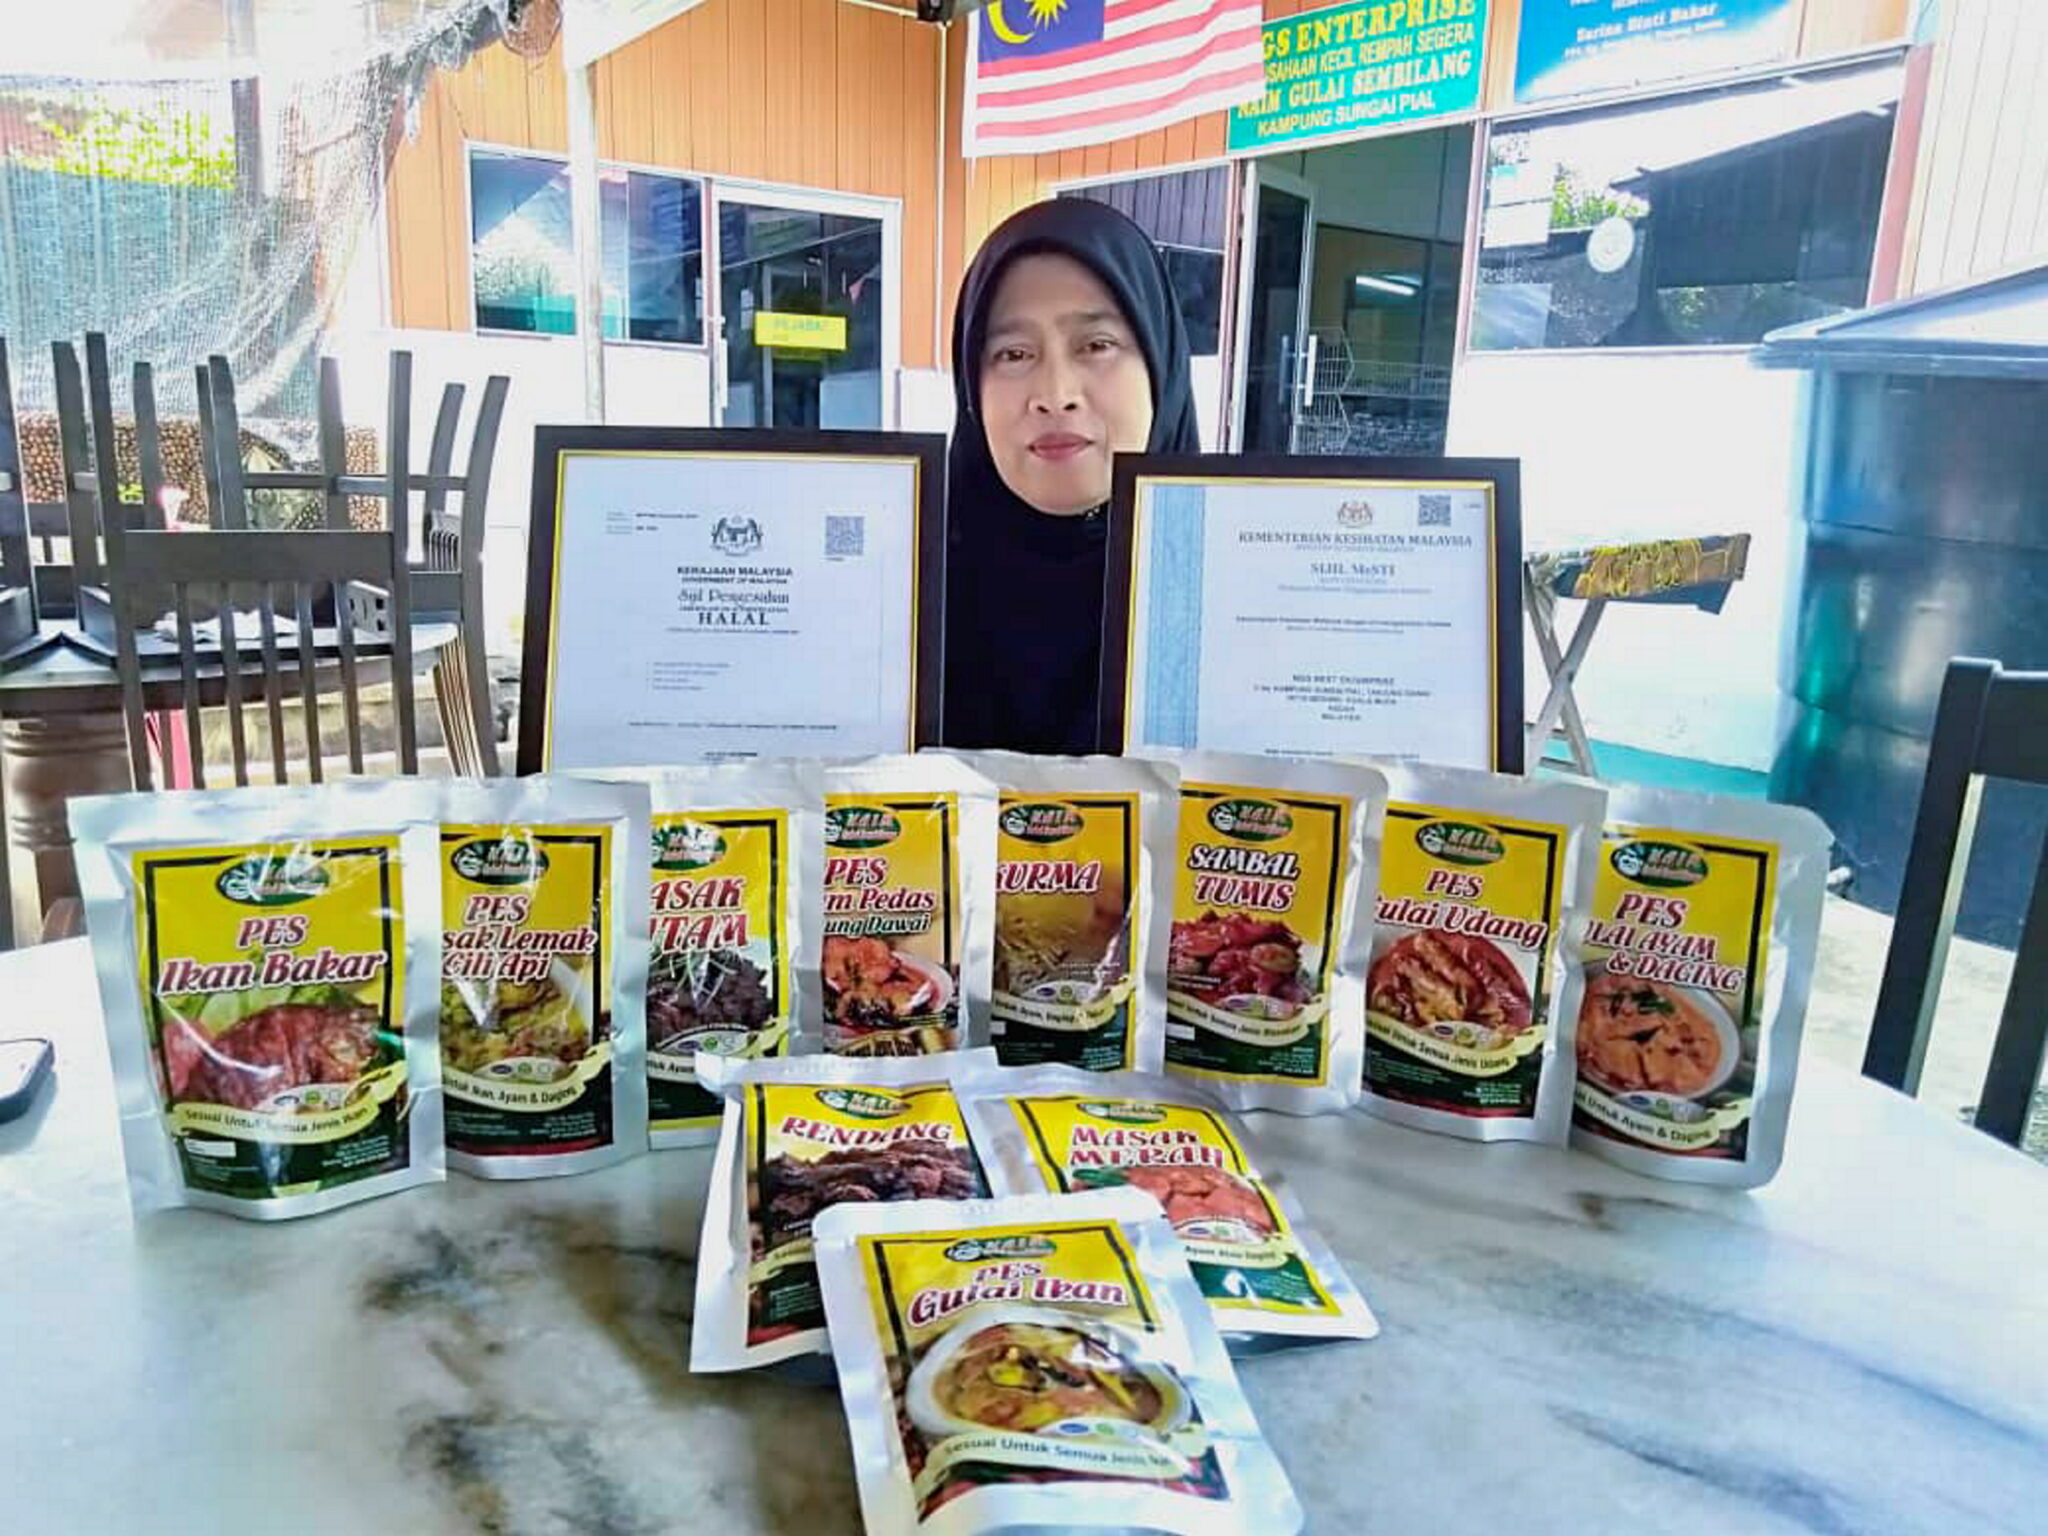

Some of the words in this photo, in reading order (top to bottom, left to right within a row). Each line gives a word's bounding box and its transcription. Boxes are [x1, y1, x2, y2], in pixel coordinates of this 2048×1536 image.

[1296, 0, 1476, 52] ENTERPRISE
[1265, 52, 1319, 82] SAHAAN
[1320, 46, 1355, 72] KECIL
[1358, 36, 1413, 65] REMPAH
[1416, 22, 1476, 52] SEGERA
[1289, 75, 1346, 108] GULAI
[1257, 108, 1332, 137] KAMPUNG
[1335, 95, 1397, 123] SUNGAI
[1238, 531, 1331, 545] KEMENTERIAN
[1334, 532, 1405, 546] KESIHATAN
[1408, 534, 1473, 548] MALAYSIA
[677, 566, 736, 576] KERAJAAN
[738, 566, 793, 577] MALAYSIA
[698, 611, 771, 626] HALAL
[823, 856, 887, 888] PES
[1187, 843, 1301, 880] SAMBAL
[859, 885, 936, 912] Pedas
[1194, 872, 1295, 912] TUMIS
[1426, 869, 1483, 898] PES
[464, 894, 529, 925] PES
[862, 913, 932, 935] Dawai
[1377, 895, 1440, 927] ulai
[1443, 904, 1548, 948] Udang
[1614, 891, 1689, 929] PES
[238, 915, 307, 948] PES
[498, 925, 599, 954] Lemak
[1637, 928, 1718, 963] AYAM
[158, 957, 255, 995] Ikan
[261, 948, 388, 989] Bakar
[496, 951, 552, 985] Api
[1606, 949, 1632, 975] &
[1635, 952, 1747, 993] DAGING
[781, 1115, 953, 1148] RENDANG
[1071, 1125, 1199, 1146] MASAK
[1069, 1145, 1224, 1168] MERAH
[973, 1261, 1044, 1284] PES
[907, 1280, 1022, 1328] Gulai
[1031, 1277, 1129, 1306] Ikan
[1001, 1436, 1049, 1453] Untuk
[1053, 1444, 1107, 1462] Semua
